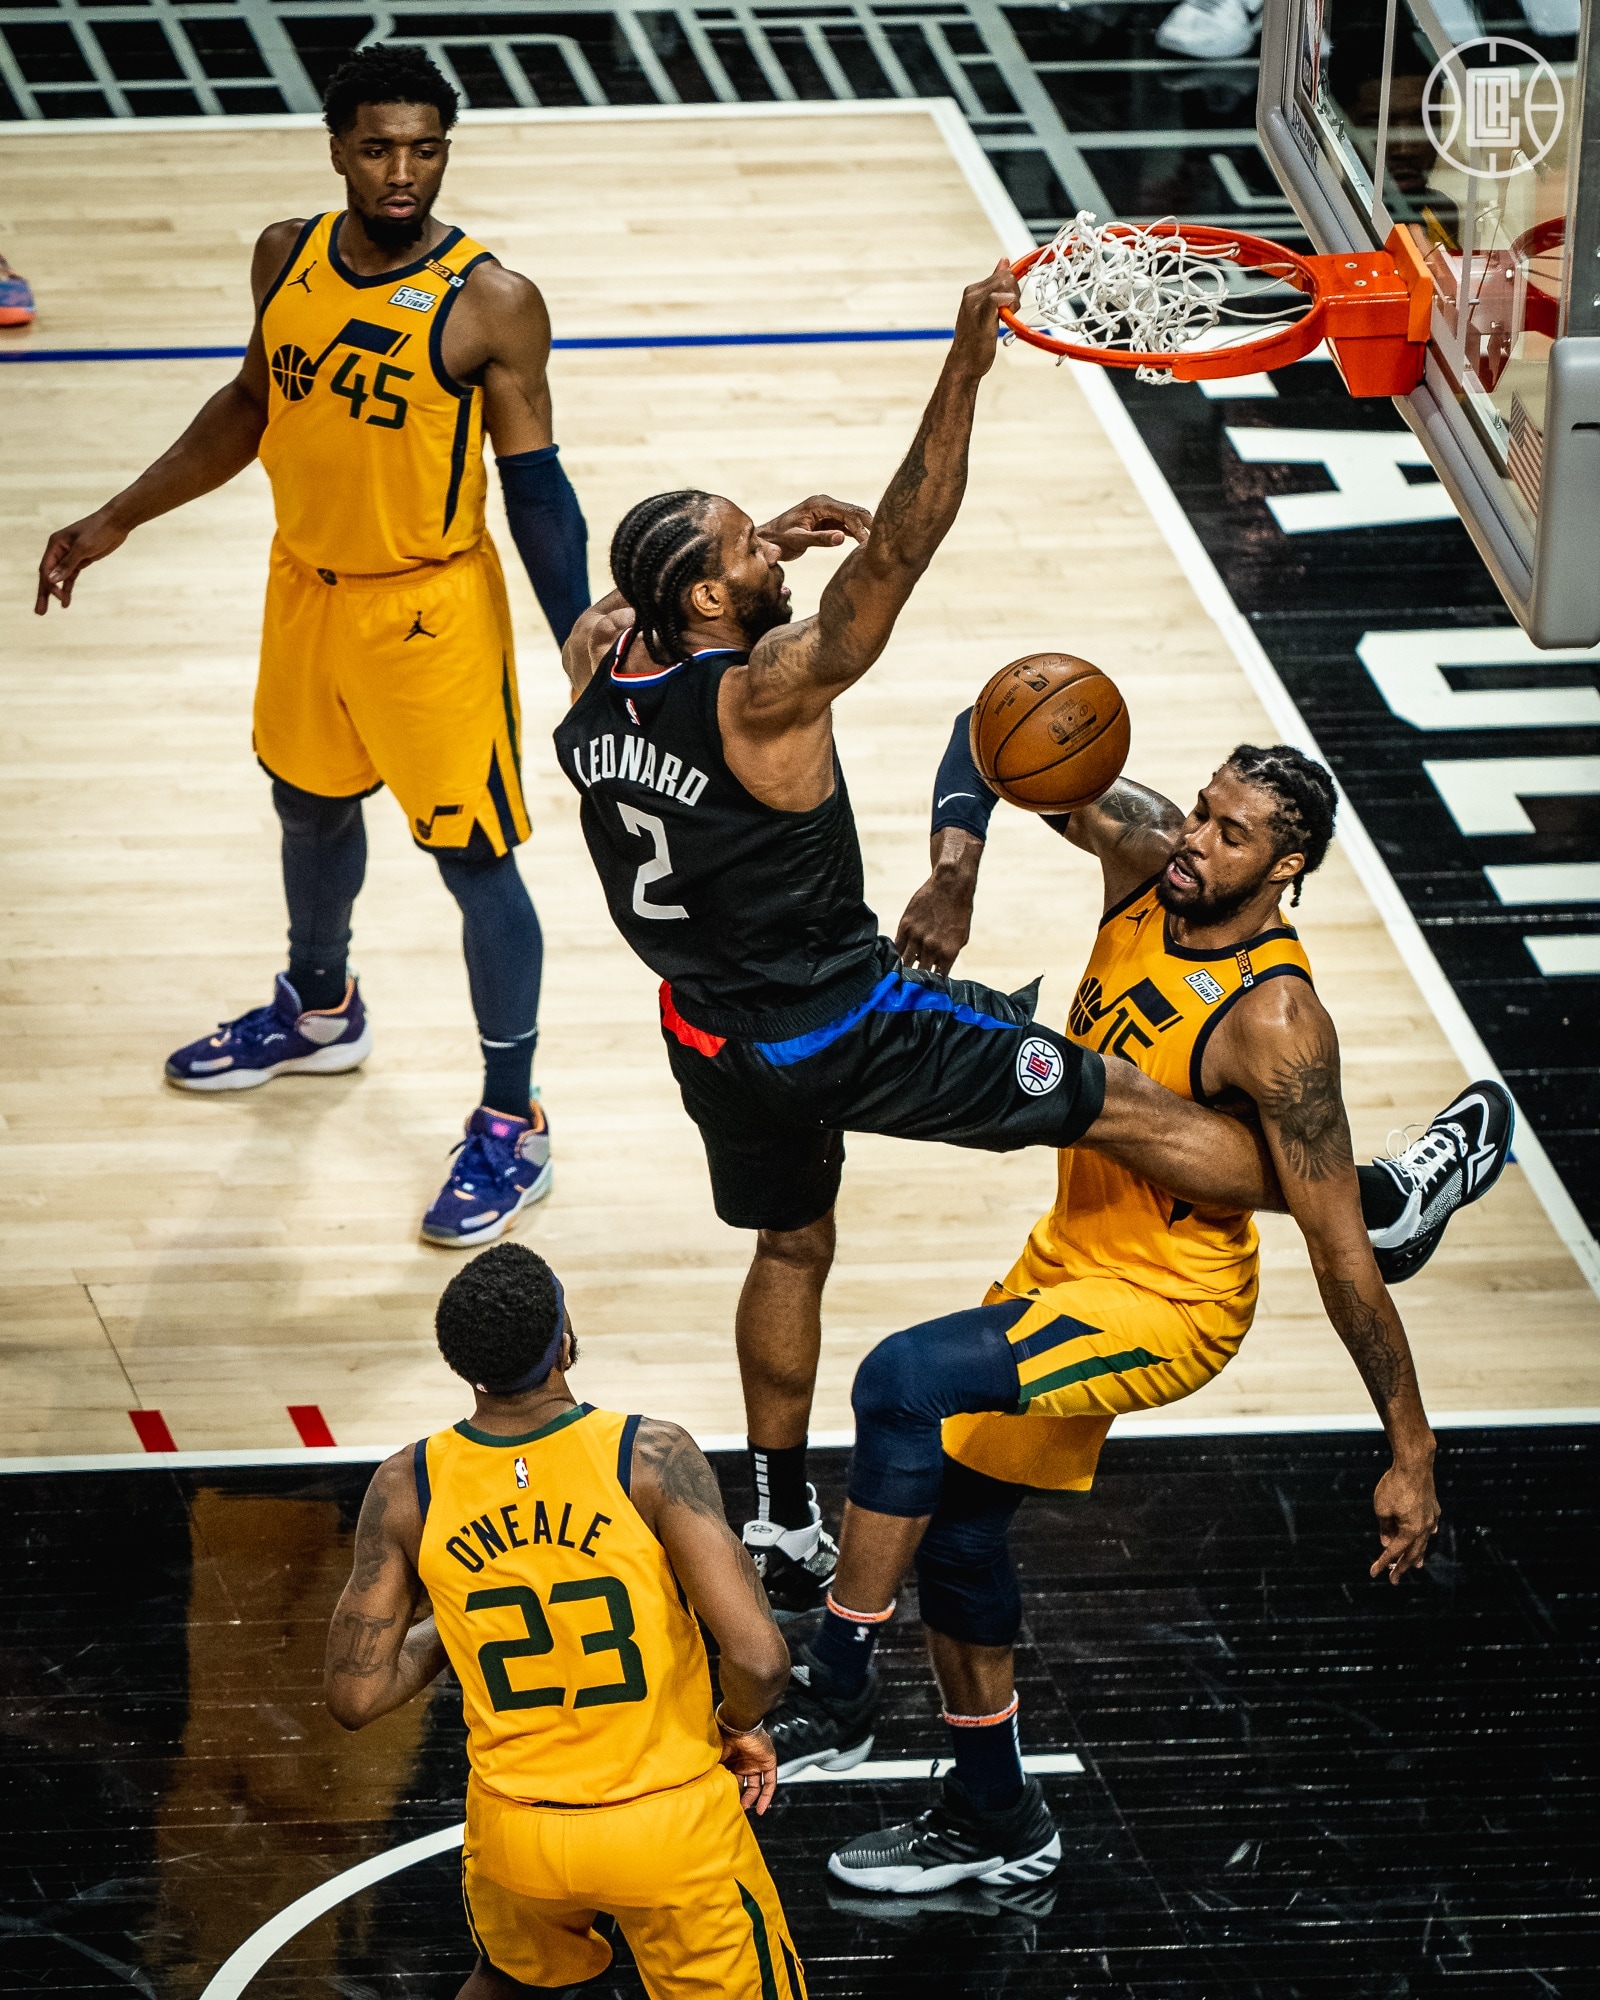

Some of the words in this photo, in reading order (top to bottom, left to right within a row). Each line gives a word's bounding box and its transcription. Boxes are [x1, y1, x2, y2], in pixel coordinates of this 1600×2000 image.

[424, 259, 451, 278] 1223
[394, 288, 410, 303] 5
[405, 298, 430, 310] FIGHT
[330, 352, 415, 430] 45
[573, 733, 709, 807] LEONARD
[616, 801, 690, 920] 2
[1235, 949, 1251, 974] 1223
[1188, 972, 1207, 983] 5
[1242, 973, 1254, 988] 53
[1194, 981, 1216, 1001] FIGHT
[445, 1500, 612, 1573] O'NEALE
[465, 1575, 648, 1713] 23
